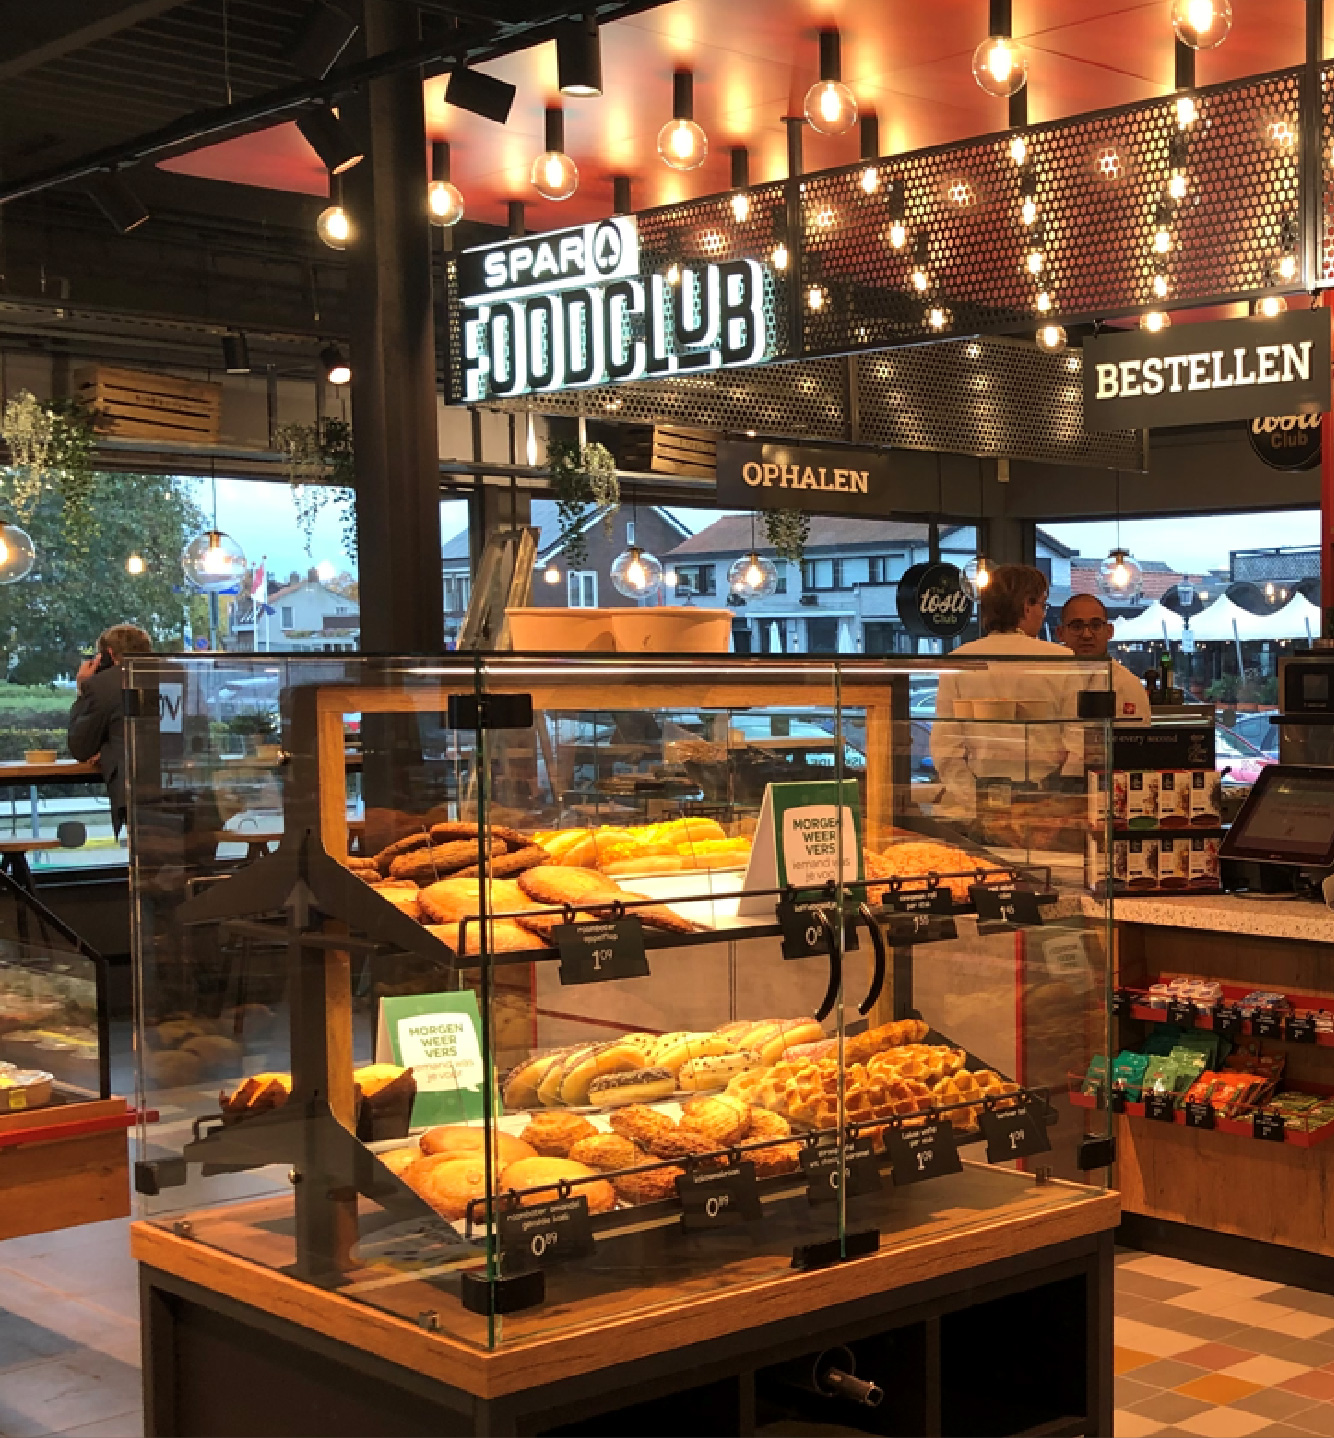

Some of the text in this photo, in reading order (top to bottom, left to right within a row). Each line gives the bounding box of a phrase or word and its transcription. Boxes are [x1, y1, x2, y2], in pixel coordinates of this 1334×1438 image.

[485, 236, 585, 288] SPAR
[461, 258, 764, 402] FOODCLUB
[1095, 341, 1314, 400] BESTELLEN
[1271, 430, 1308, 448] Club
[742, 461, 870, 494] OPHALEN
[920, 588, 967, 613] tosti
[802, 831, 835, 843] WEER
[805, 843, 835, 856] VERS
[408, 1022, 464, 1037] MORGEN
[420, 1035, 457, 1047] WEER
[424, 1046, 458, 1059] VERS
